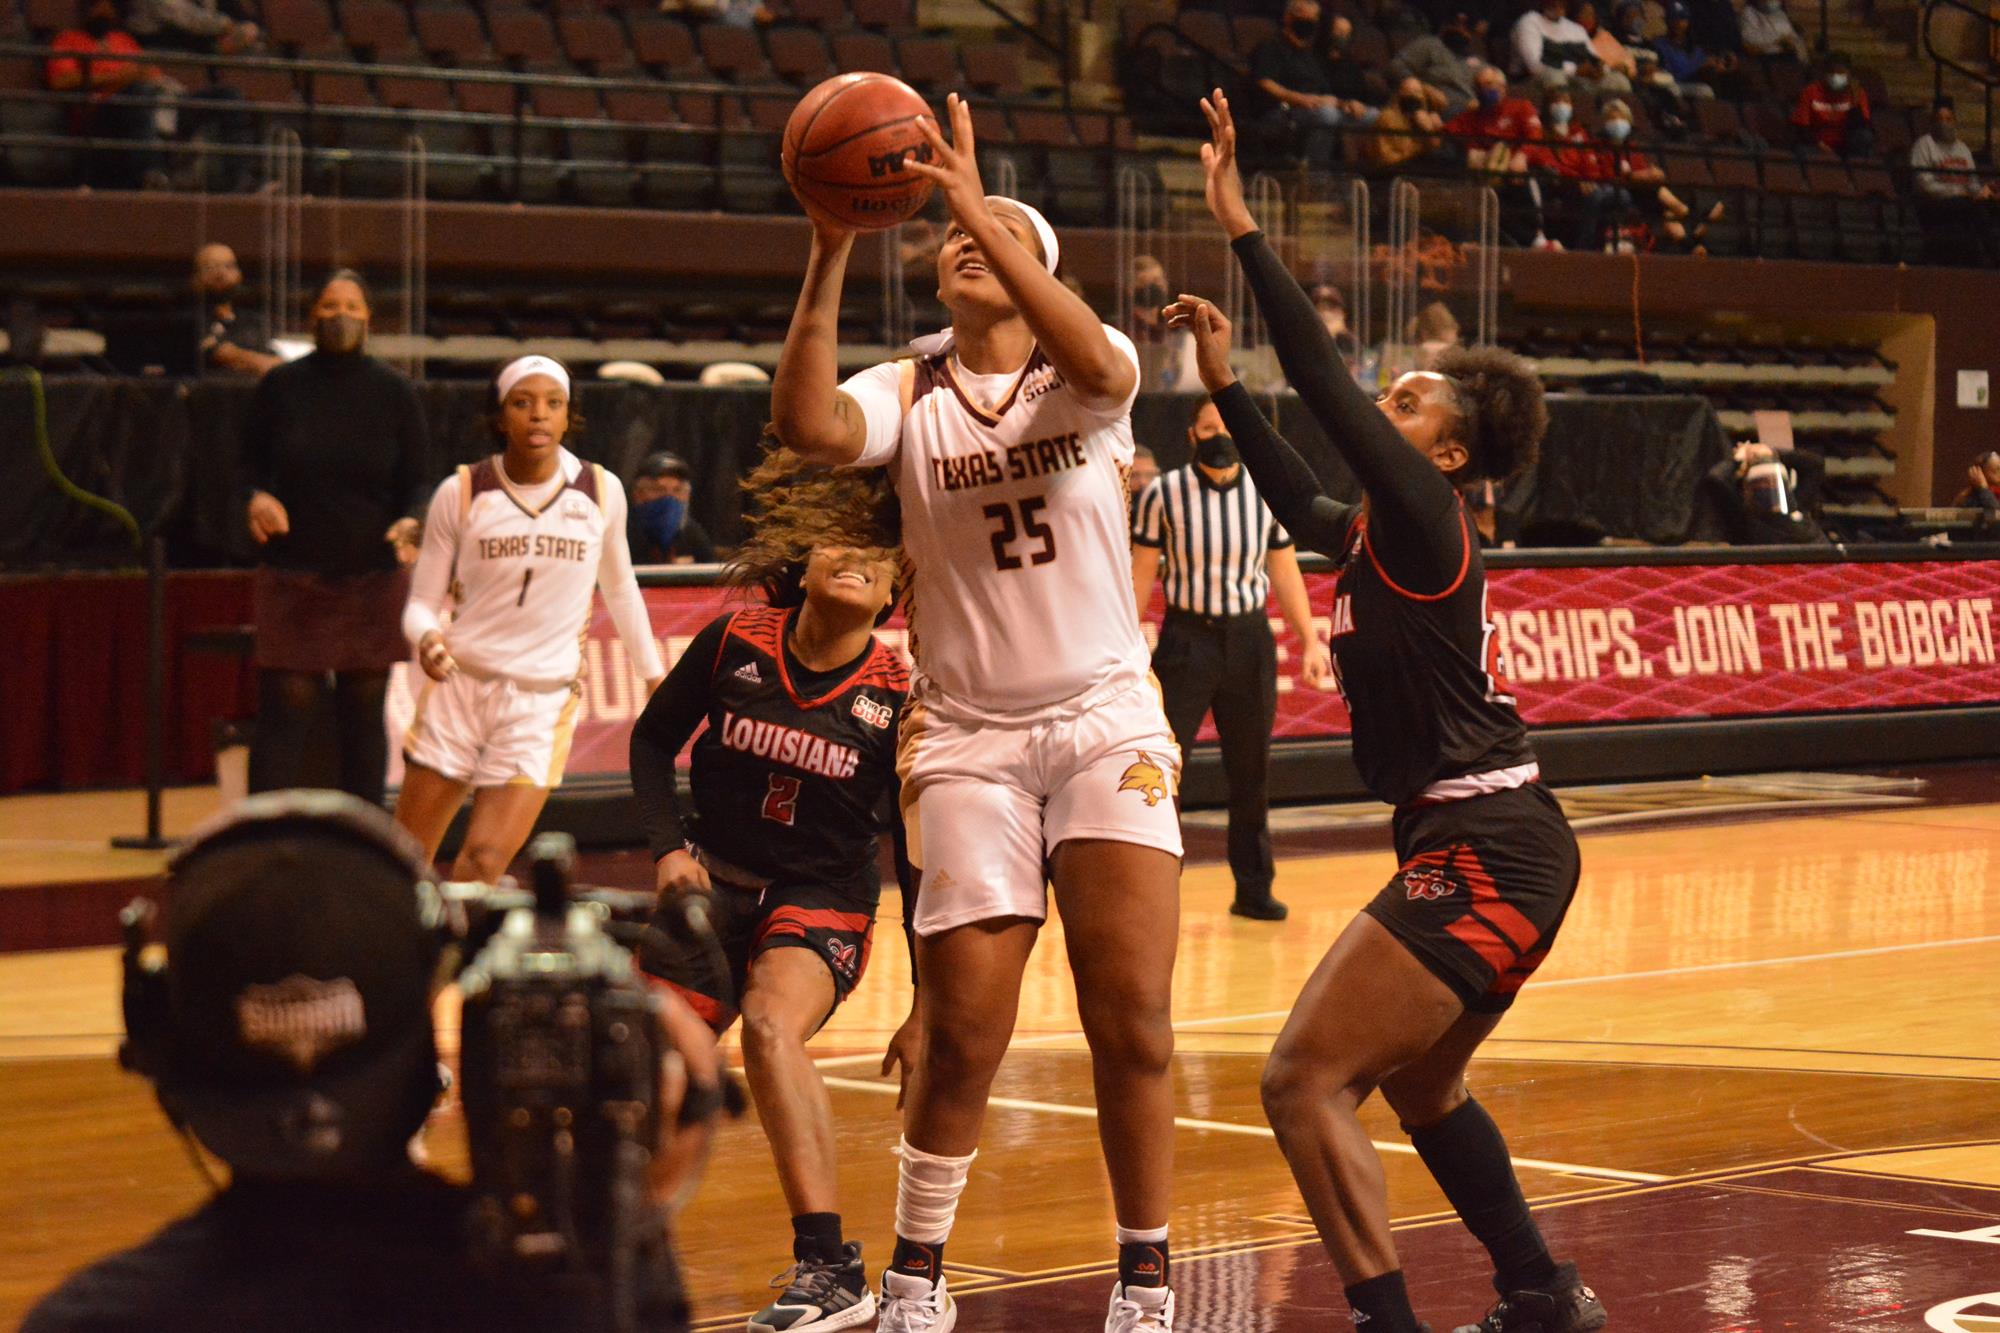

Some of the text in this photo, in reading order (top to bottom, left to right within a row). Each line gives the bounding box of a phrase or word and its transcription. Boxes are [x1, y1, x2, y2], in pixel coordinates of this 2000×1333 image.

[931, 431, 1088, 492] TEXAS STATE
[478, 534, 587, 562] TEXAS STATE
[982, 494, 1056, 572] 25
[516, 567, 534, 608] 1
[1665, 603, 1763, 677] JOIN
[1769, 601, 1848, 673] THE
[1854, 597, 1996, 670] BOBCAT
[851, 694, 893, 737] SBC
[721, 710, 861, 779] LOUISIANA
[761, 772, 802, 826] 2
